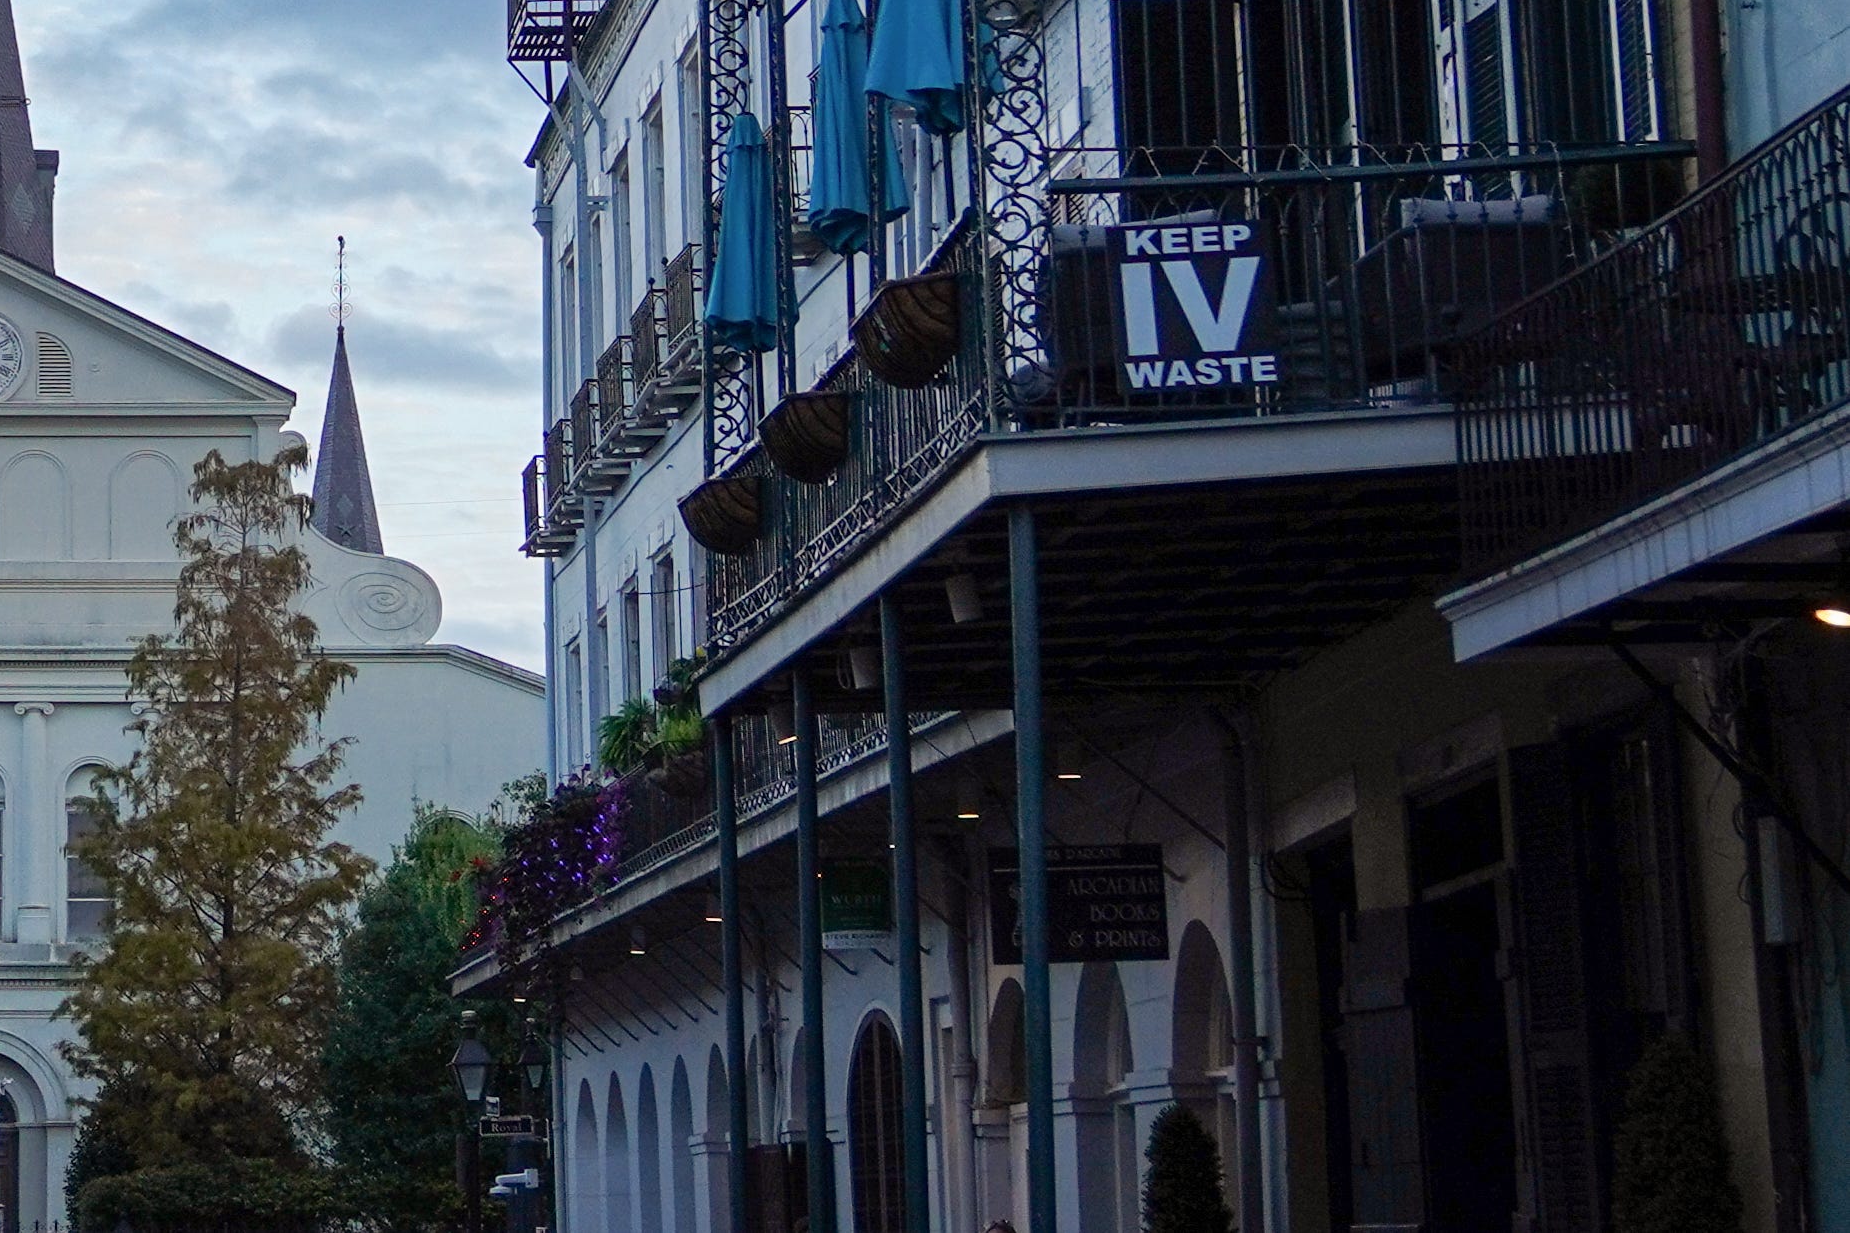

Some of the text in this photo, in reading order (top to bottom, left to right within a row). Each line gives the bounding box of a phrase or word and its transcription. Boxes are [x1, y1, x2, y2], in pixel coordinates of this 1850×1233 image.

[1125, 224, 1251, 256] KEEP
[1120, 256, 1261, 357] IV
[1124, 355, 1278, 389] WASTE
[1090, 903, 1160, 923] BOOKS
[1095, 929, 1161, 948] PRINTS
